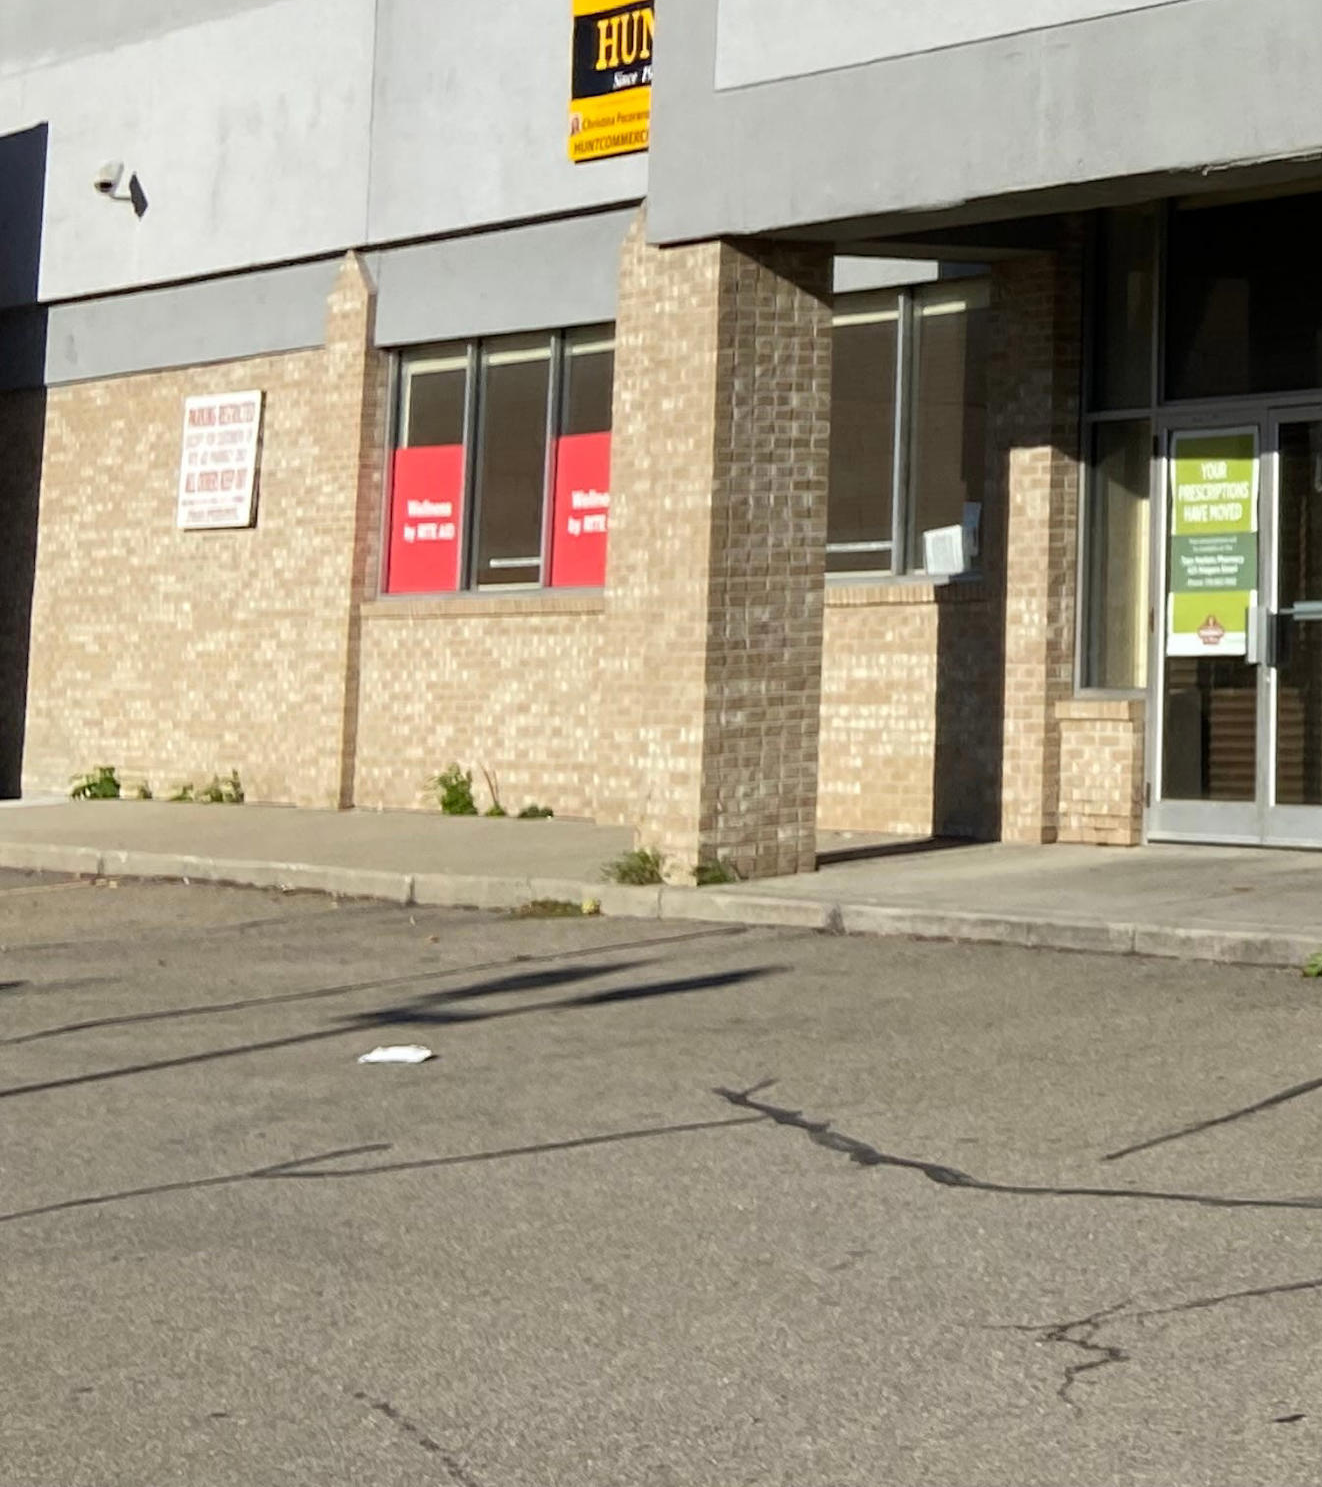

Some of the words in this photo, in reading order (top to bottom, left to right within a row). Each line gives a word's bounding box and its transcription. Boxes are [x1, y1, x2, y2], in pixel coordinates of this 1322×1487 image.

[612, 70, 638, 91] Since
[1201, 460, 1228, 481] YOUR
[1178, 481, 1250, 503] PRESCRIPTIONS
[1183, 504, 1208, 523] HAVE
[1208, 502, 1243, 522] MOVED
[404, 523, 416, 544] by
[567, 516, 581, 537] by
